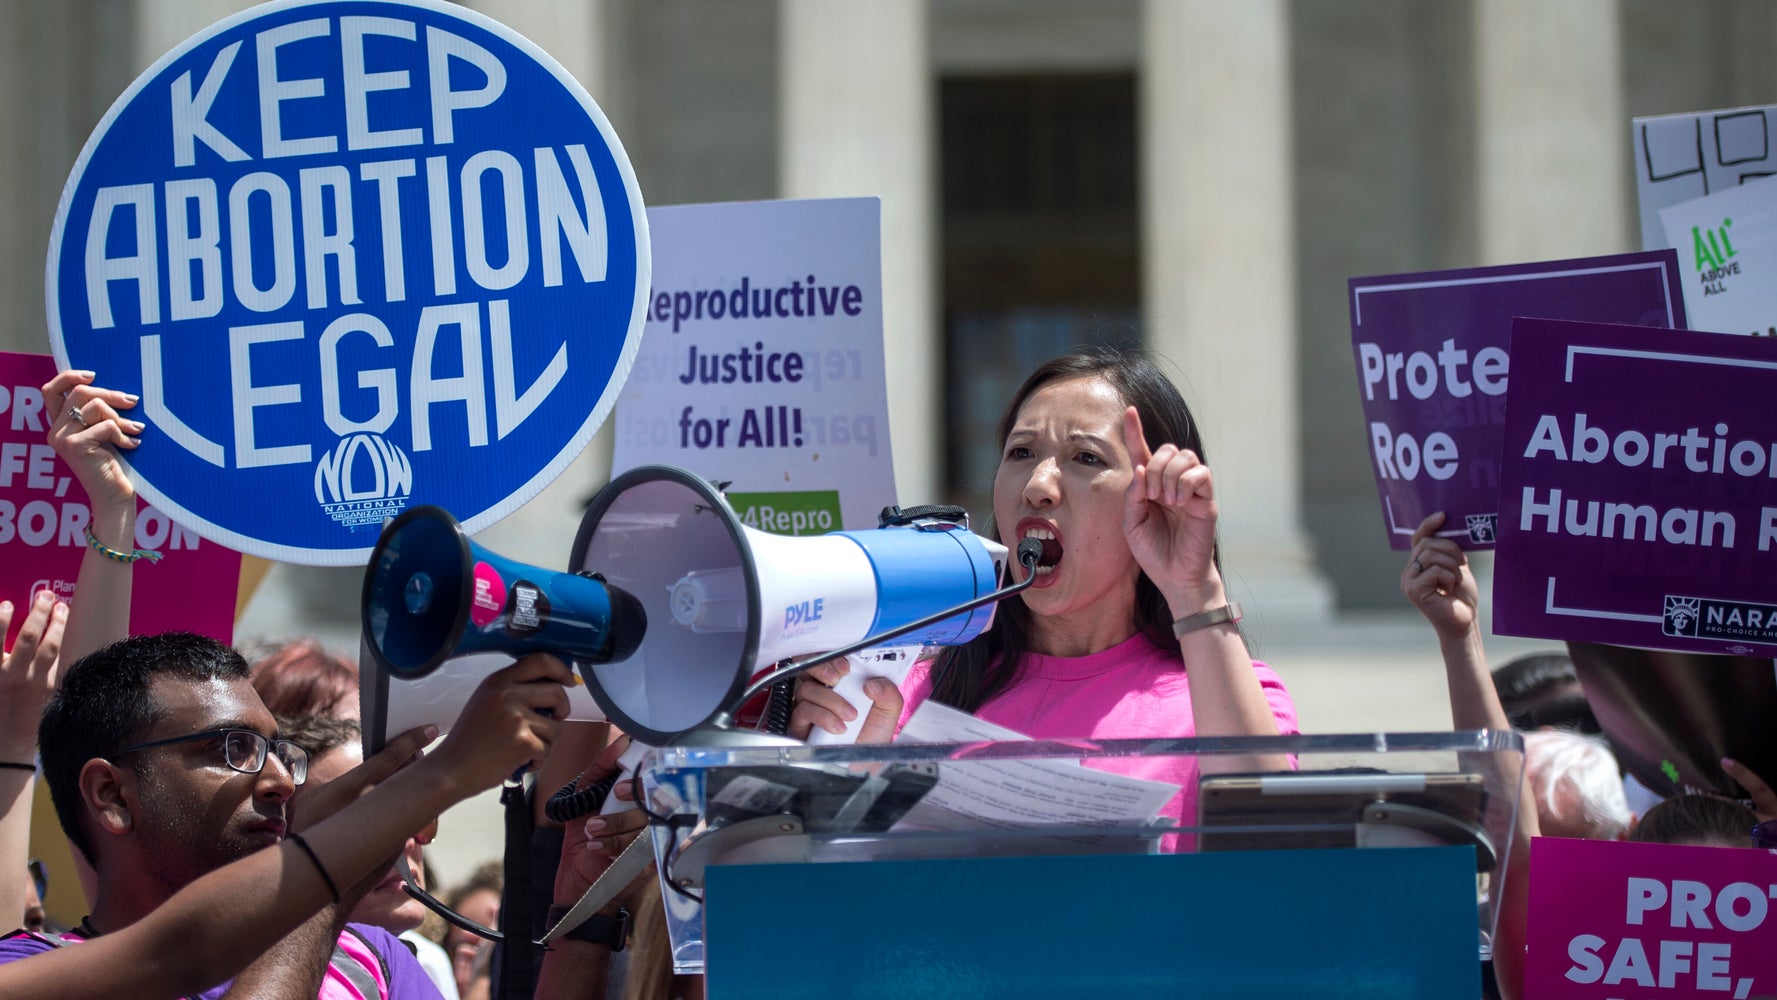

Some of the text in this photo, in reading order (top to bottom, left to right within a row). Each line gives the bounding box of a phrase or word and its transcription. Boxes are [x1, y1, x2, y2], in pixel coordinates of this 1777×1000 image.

[171, 15, 507, 167] KEEP
[85, 144, 608, 329] ABORTION
[1704, 281, 1727, 297] ALL
[140, 299, 568, 469] LEGAL
[679, 341, 803, 385] Justice
[1359, 337, 1510, 400] Prote
[678, 406, 730, 449] for
[737, 405, 804, 448] All!
[1370, 422, 1459, 481] Roe
[314, 434, 412, 504] NOW
[324, 499, 405, 513] NATIONAL
[332, 508, 398, 521] ORGANIZATION
[1520, 486, 1736, 548] Human
[784, 598, 823, 629] PYLE
[1626, 877, 1777, 932] PRO
[1564, 934, 1754, 999] SAFE,
